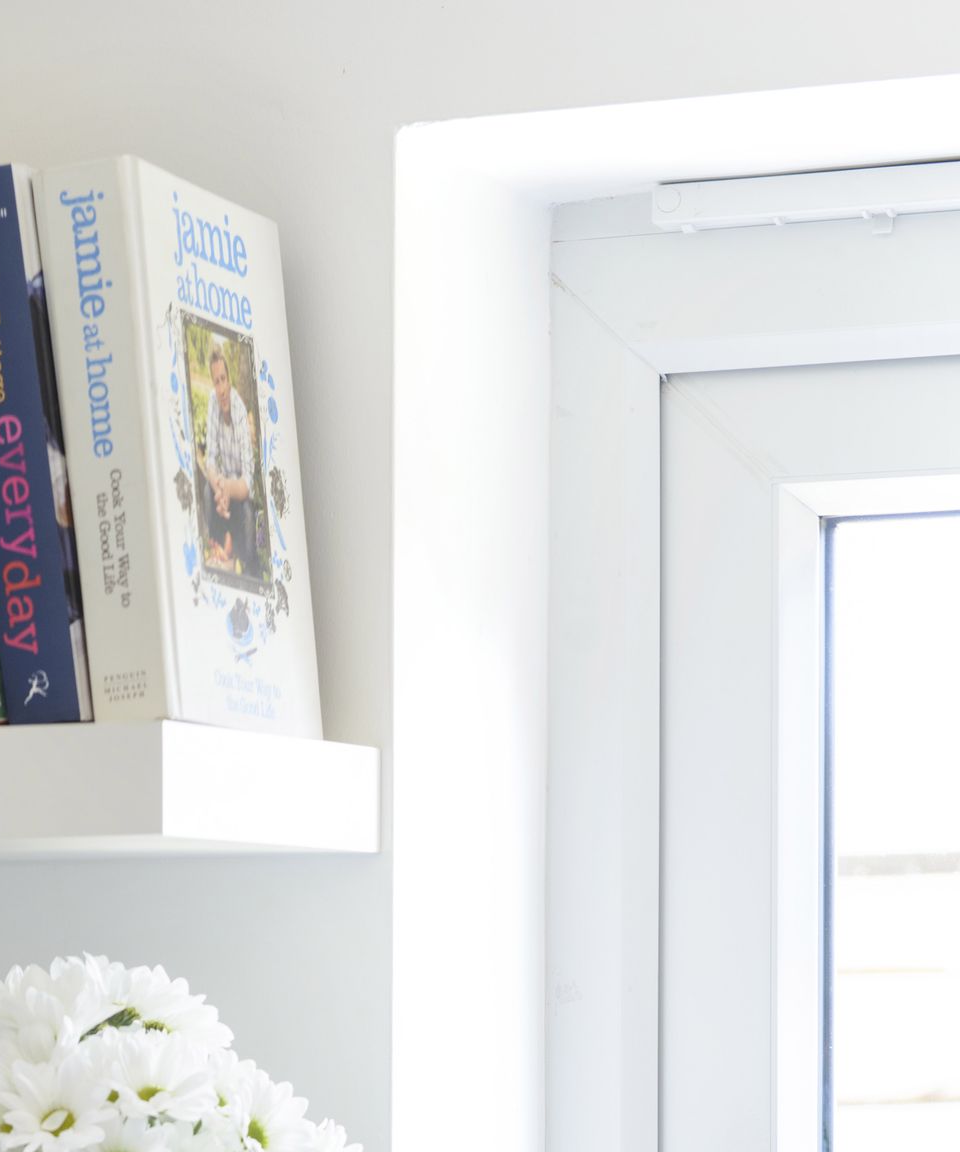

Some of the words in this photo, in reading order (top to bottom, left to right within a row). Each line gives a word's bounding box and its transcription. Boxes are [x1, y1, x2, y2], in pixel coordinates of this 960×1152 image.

[172, 191, 249, 278] jamie
[59, 190, 113, 320] jamie
[177, 274, 194, 304] at
[191, 263, 253, 331] home
[83, 324, 103, 352] at
[85, 352, 115, 458] home
[96, 492, 108, 517] the
[110, 468, 124, 509] Cook
[99, 520, 113, 561] Good
[114, 511, 126, 551] Your
[103, 564, 116, 595] Life
[117, 553, 130, 588] Way
[121, 592, 132, 608] to
[104, 670, 147, 683] PENGUIN
[104, 682, 147, 695] MICHAEL
[109, 691, 146, 703] JOSEPH
